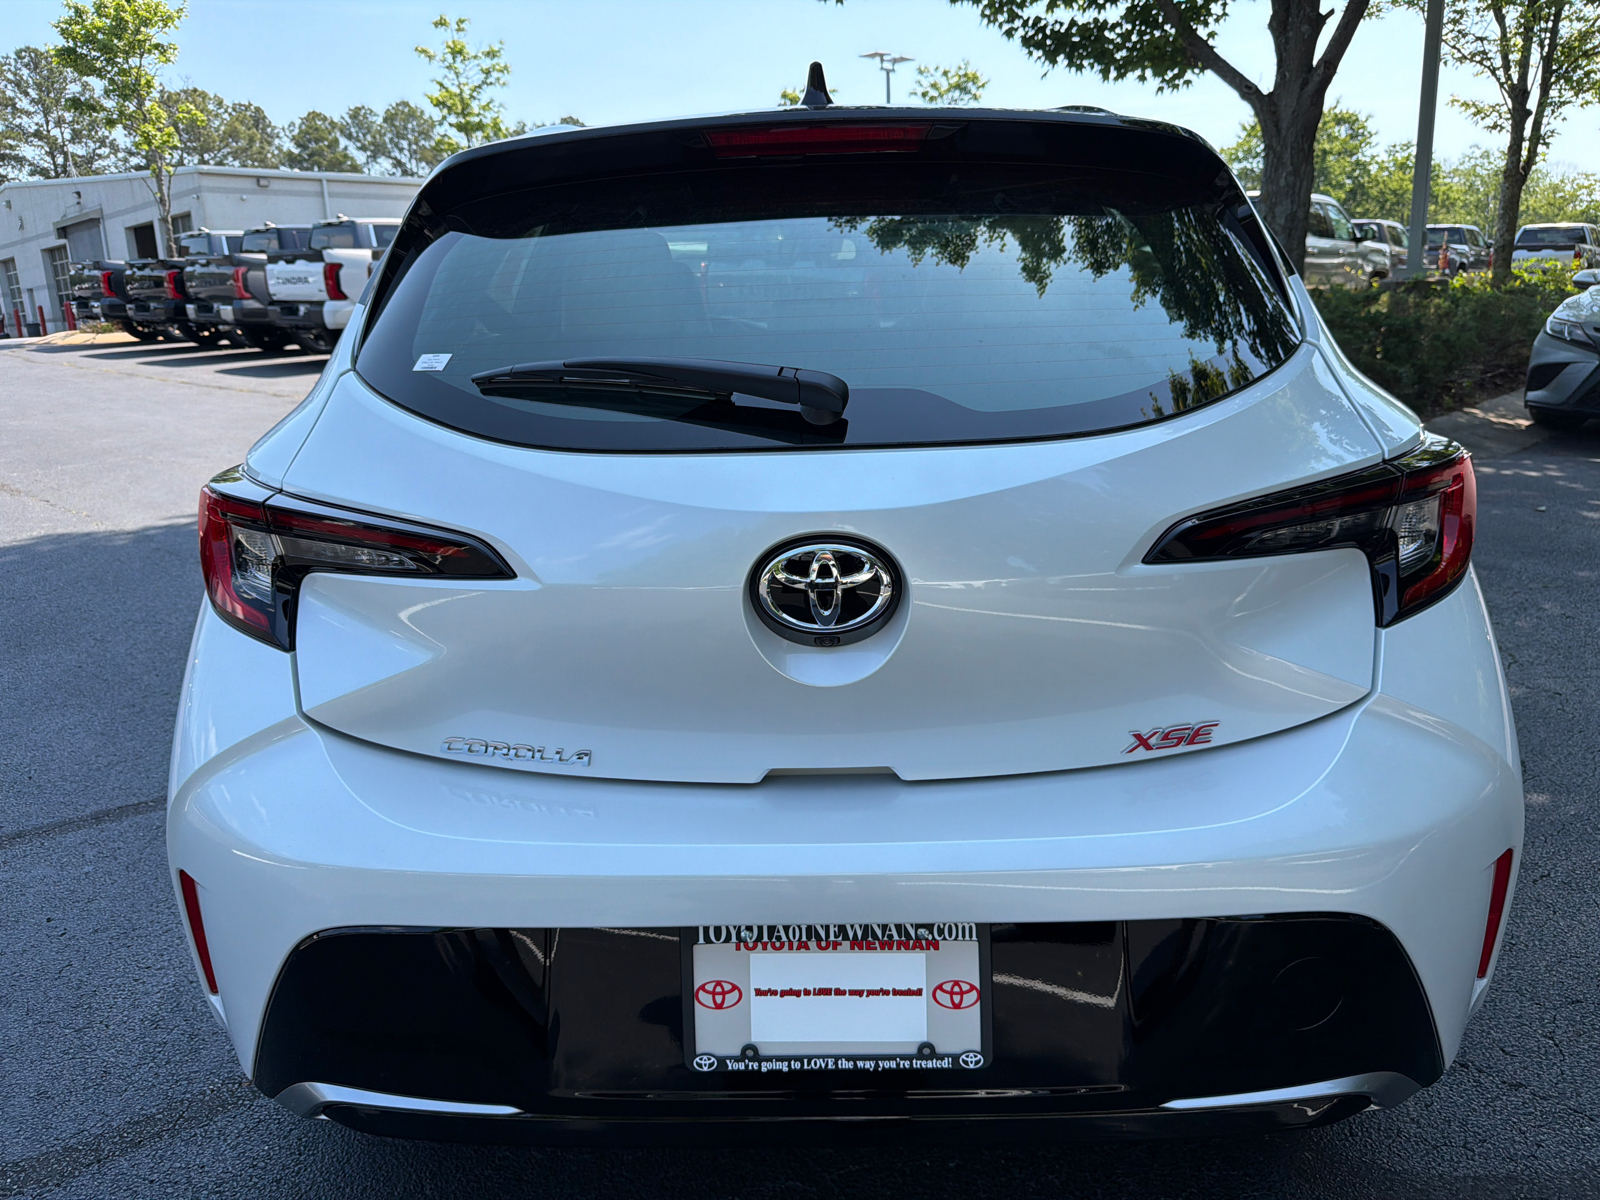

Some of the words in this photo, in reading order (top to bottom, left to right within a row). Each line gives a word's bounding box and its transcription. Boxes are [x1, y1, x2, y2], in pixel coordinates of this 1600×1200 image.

[1120, 720, 1221, 754] XSE
[440, 736, 592, 767] COROLLA
[735, 940, 811, 951] TOYOTA
[815, 940, 842, 951] OF
[850, 940, 939, 951] NEWNAN
[754, 988, 778, 997] You're
[779, 987, 802, 998] going
[803, 987, 812, 996] to
[812, 987, 833, 996] LOVE
[833, 987, 847, 996] the
[848, 988, 865, 998] way
[865, 987, 891, 998] you're
[892, 987, 923, 997] treated!
[725, 1059, 759, 1070] You're
[760, 1059, 789, 1072] going
[790, 1060, 801, 1070] to
[803, 1058, 836, 1069] LOVE
[838, 1058, 854, 1069] the
[856, 1060, 876, 1071] way
[877, 1058, 911, 1071] you're
[912, 1057, 952, 1069] treated!
